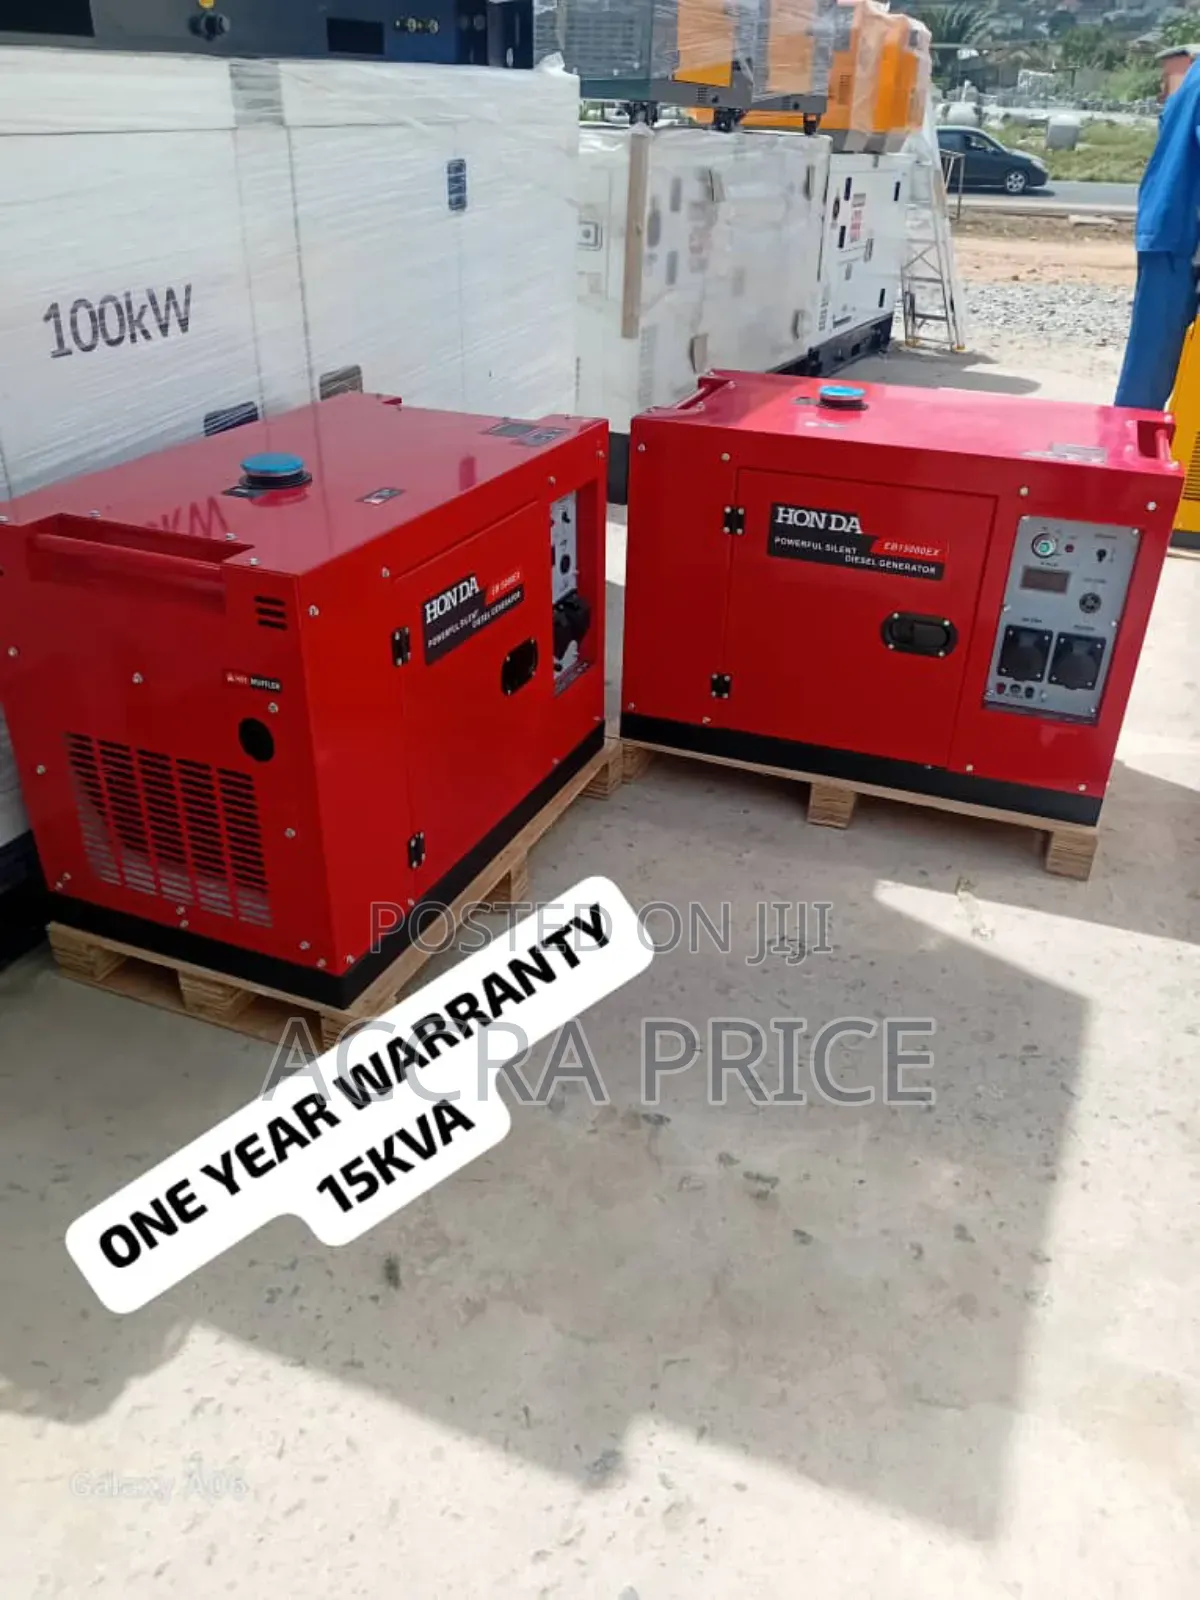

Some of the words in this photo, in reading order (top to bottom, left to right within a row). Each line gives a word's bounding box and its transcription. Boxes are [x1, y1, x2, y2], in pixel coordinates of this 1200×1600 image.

[43, 283, 192, 358] 100kW
[775, 506, 863, 534] HONDA
[774, 536, 823, 551] POWERFUL
[825, 543, 857, 555] SILENT
[845, 554, 876, 567] DIESEL
[879, 559, 936, 575] GENERATOR
[425, 576, 480, 625] HONDA
[428, 623, 460, 648] POWERFUL
